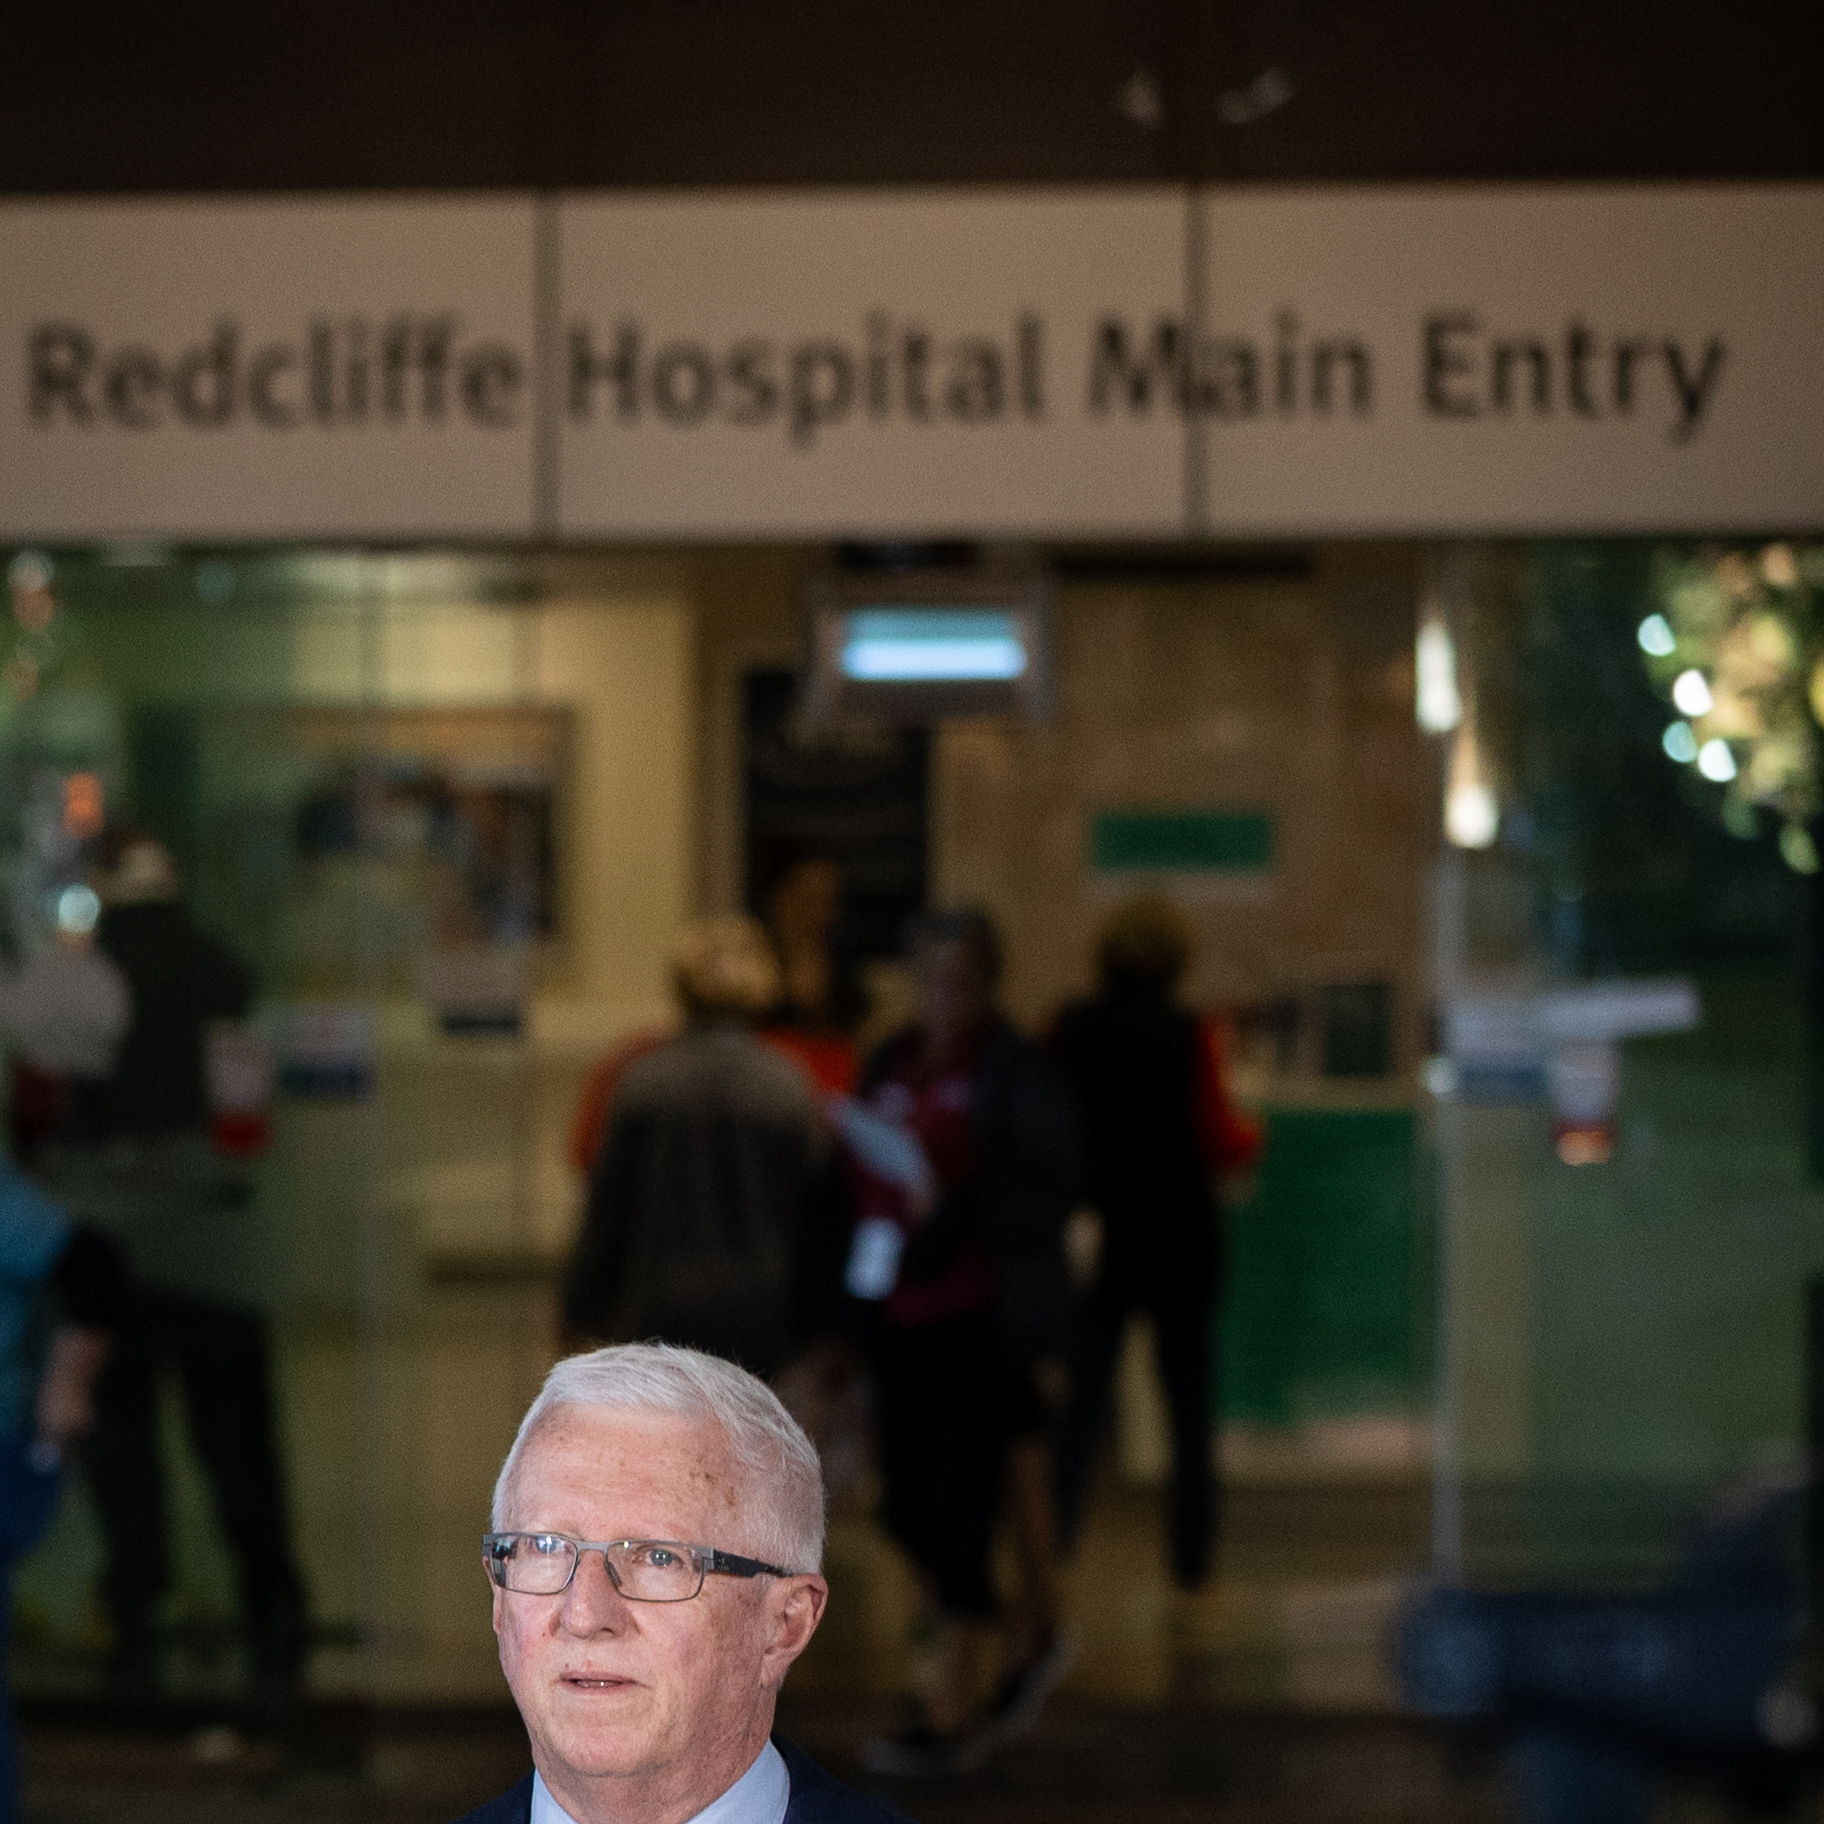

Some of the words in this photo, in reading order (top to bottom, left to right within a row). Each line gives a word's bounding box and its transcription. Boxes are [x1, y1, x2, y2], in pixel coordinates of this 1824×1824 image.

[28, 314, 523, 430] Redcliffe
[565, 310, 1043, 450] Hospital
[1089, 308, 1372, 421] Main
[1420, 310, 1729, 447] Entry
